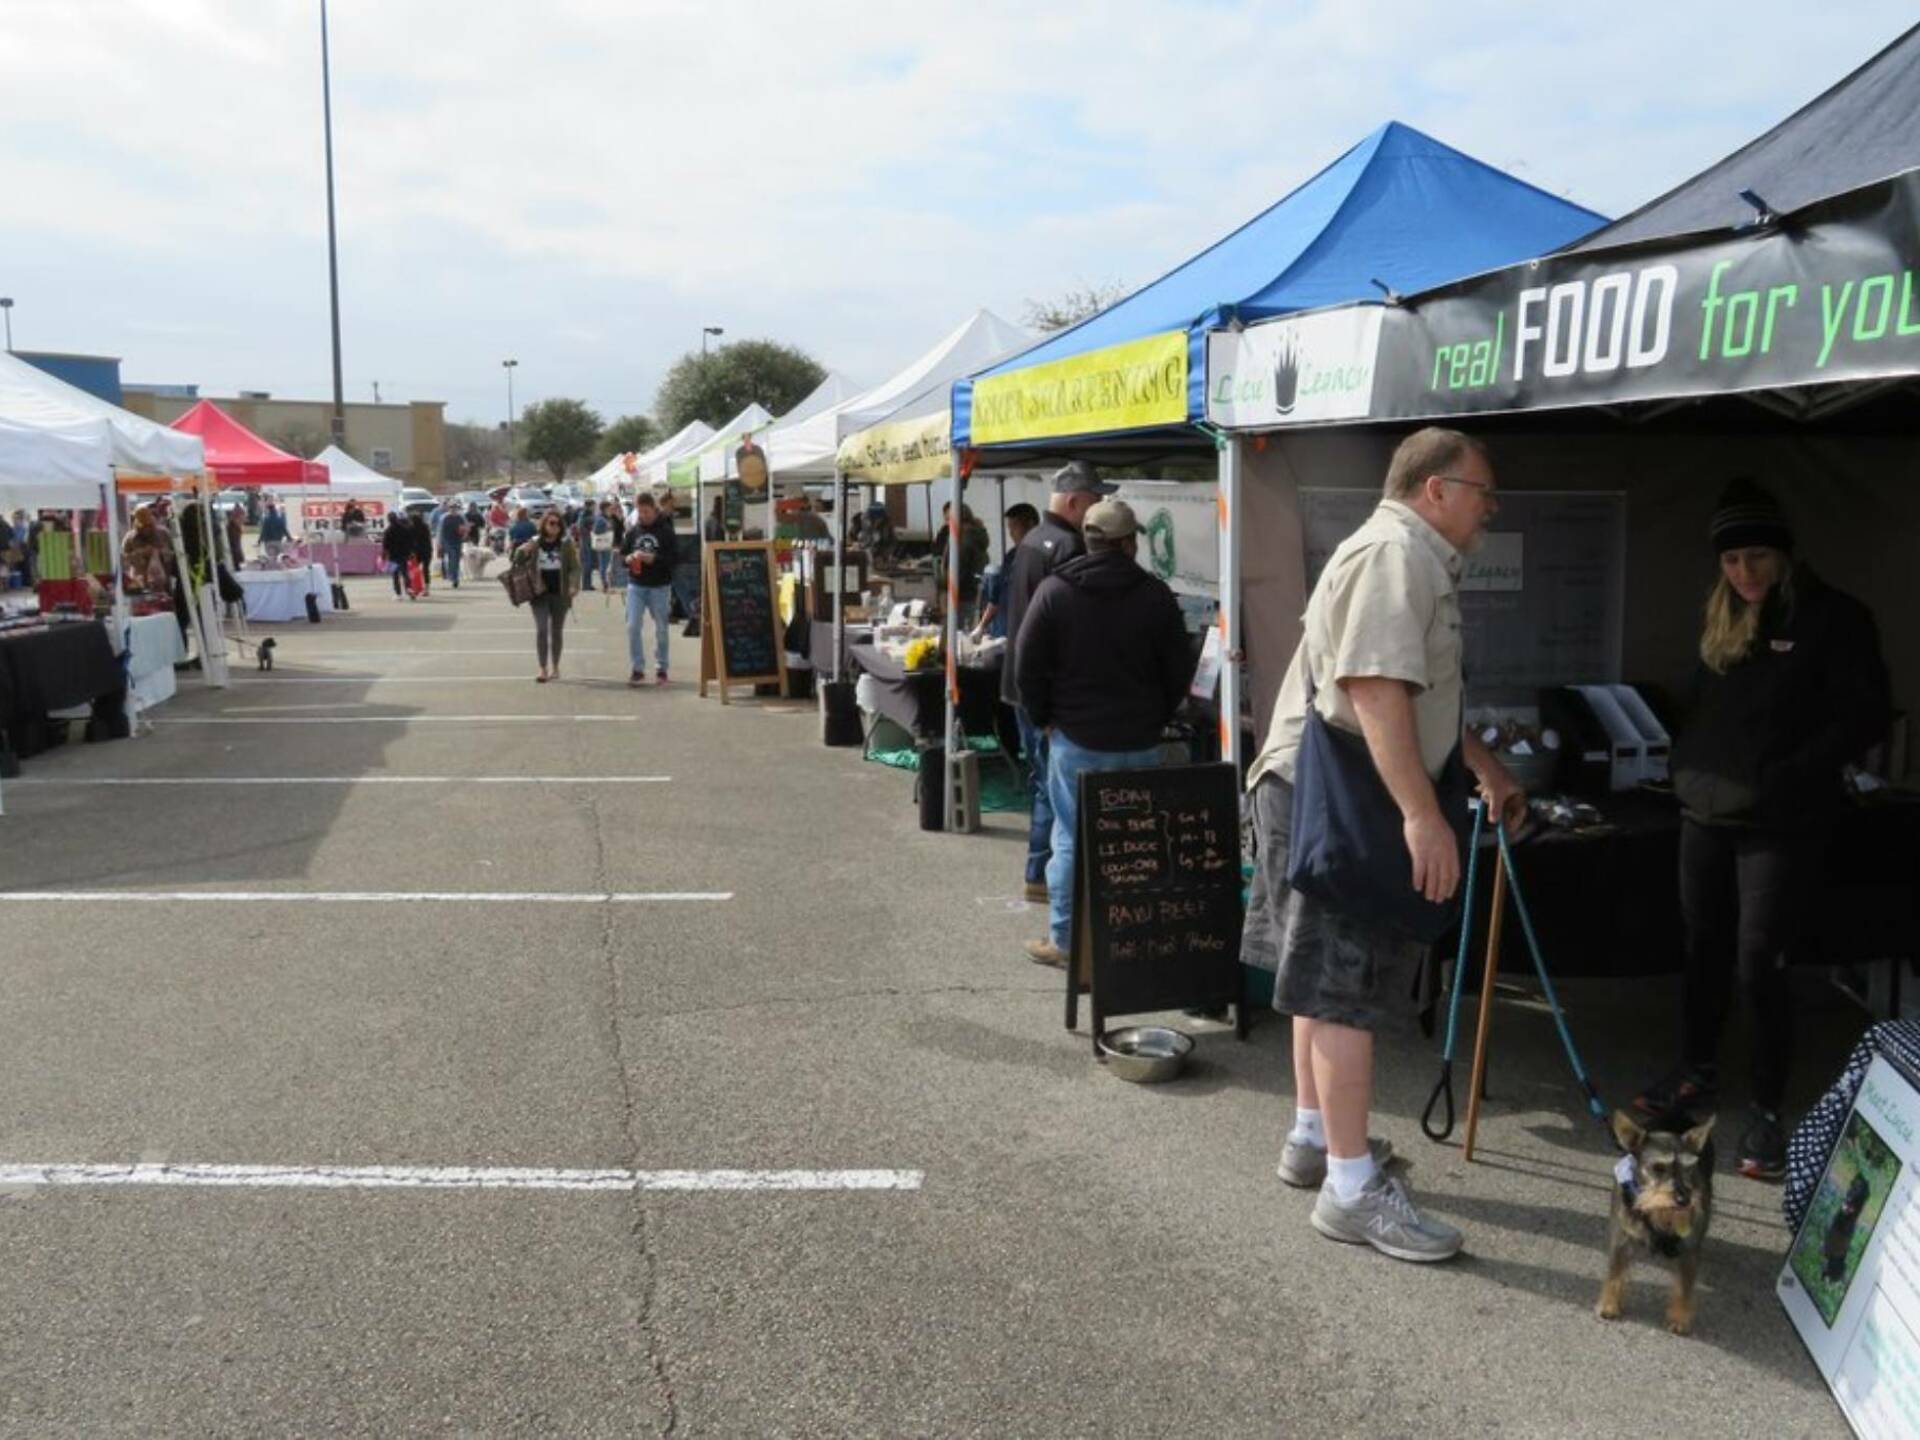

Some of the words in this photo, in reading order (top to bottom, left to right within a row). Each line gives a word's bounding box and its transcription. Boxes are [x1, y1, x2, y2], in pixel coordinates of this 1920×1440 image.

[1432, 311, 1504, 390] real
[1513, 265, 1678, 381] FOOD
[1699, 260, 1797, 360] for
